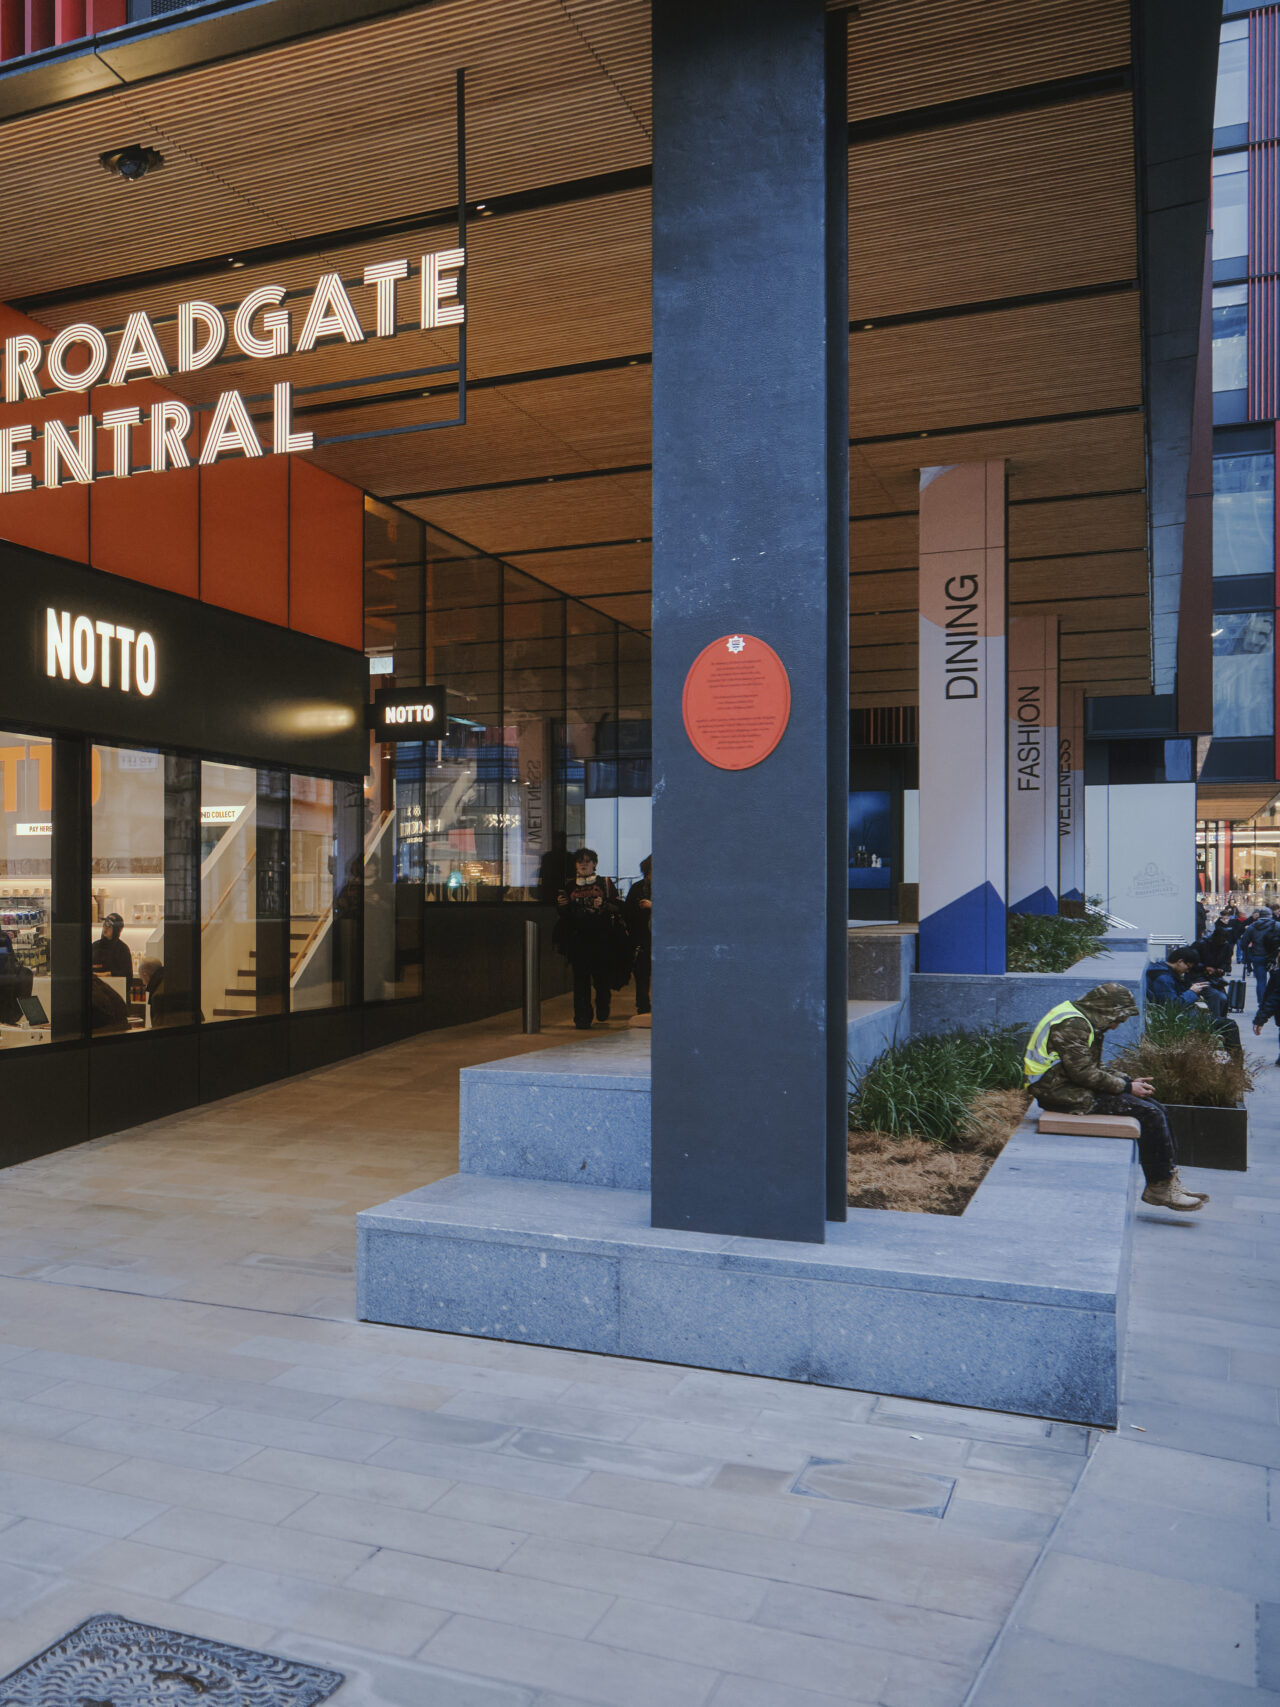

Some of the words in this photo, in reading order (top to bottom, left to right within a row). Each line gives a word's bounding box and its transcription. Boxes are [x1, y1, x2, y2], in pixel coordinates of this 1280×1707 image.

[46, 607, 156, 697] NOTTO
[944, 574, 978, 700] DINING
[385, 704, 435, 724] NOTTO
[1017, 685, 1040, 791] FASHION
[29, 825, 39, 833] PAY
[201, 811, 211, 819] ND
[212, 810, 236, 818] COLLECT
[1059, 738, 1071, 837] WELLNESS
